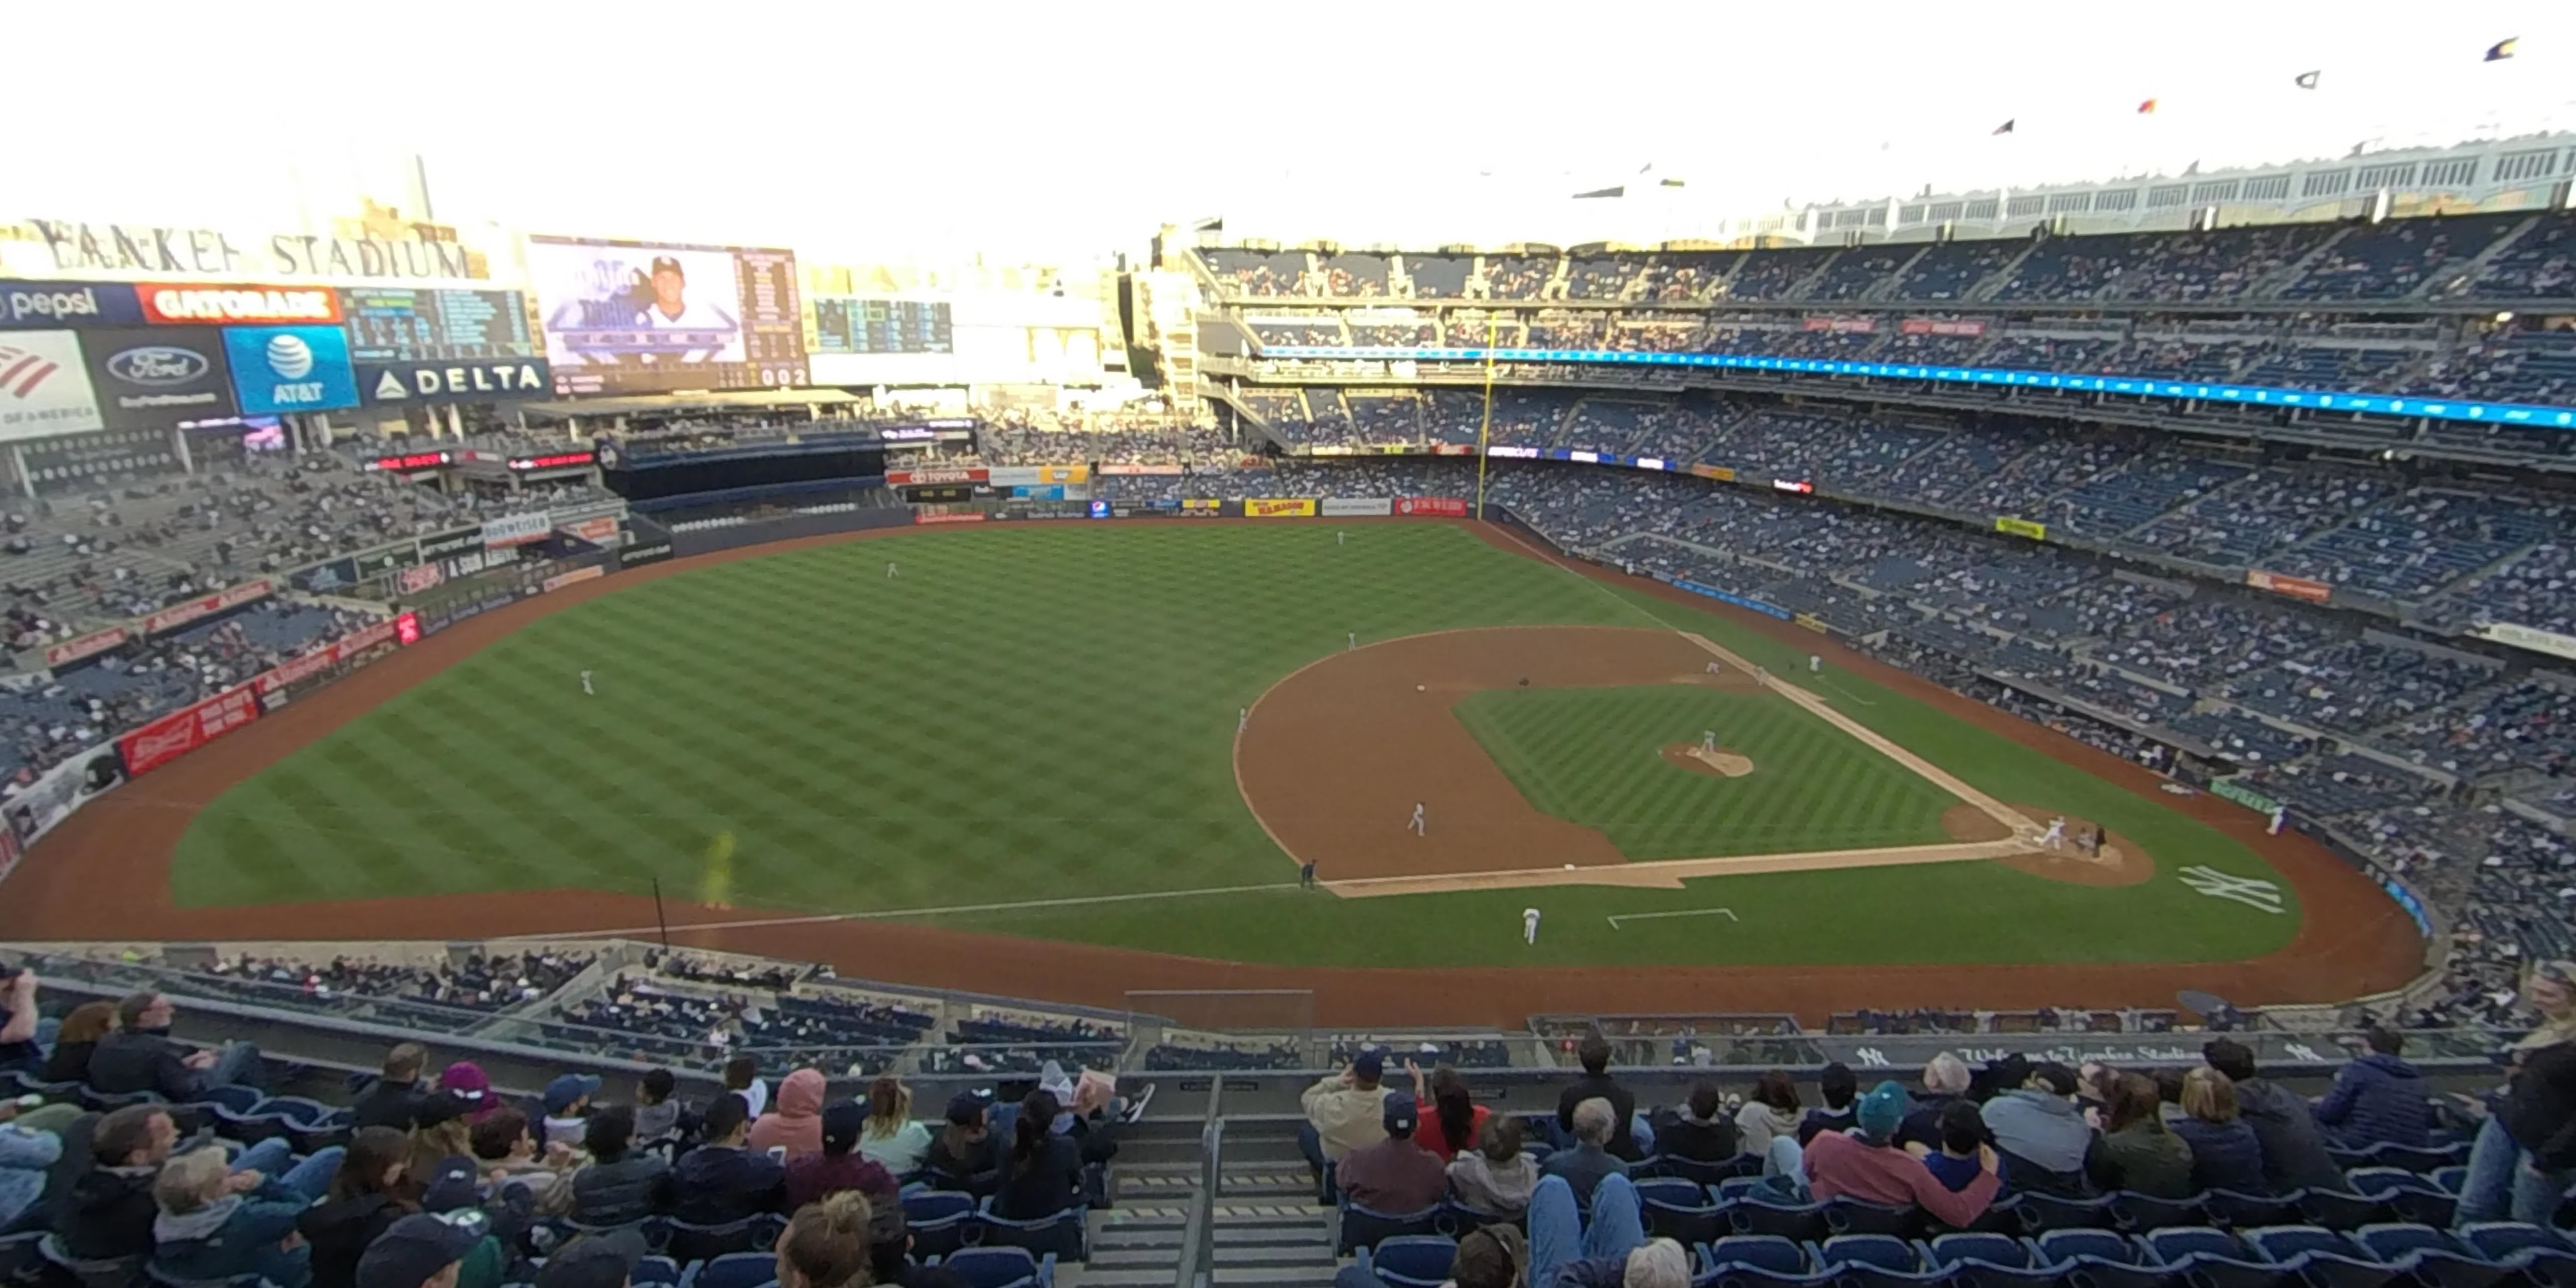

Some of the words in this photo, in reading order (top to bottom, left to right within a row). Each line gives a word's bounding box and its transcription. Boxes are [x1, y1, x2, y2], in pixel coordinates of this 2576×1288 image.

[272, 234, 472, 280] STADIUM
[10, 287, 98, 321] pepsi
[154, 289, 330, 319] GATORADE
[129, 352, 189, 378] Ford
[762, 369, 774, 386] 0
[778, 369, 790, 385] 0
[795, 369, 806, 385] 2
[273, 382, 323, 404] AT&T
[415, 365, 542, 395] DELTA
[27, 407, 94, 423] AMERICA
[927, 471, 970, 481] TOYOTA
